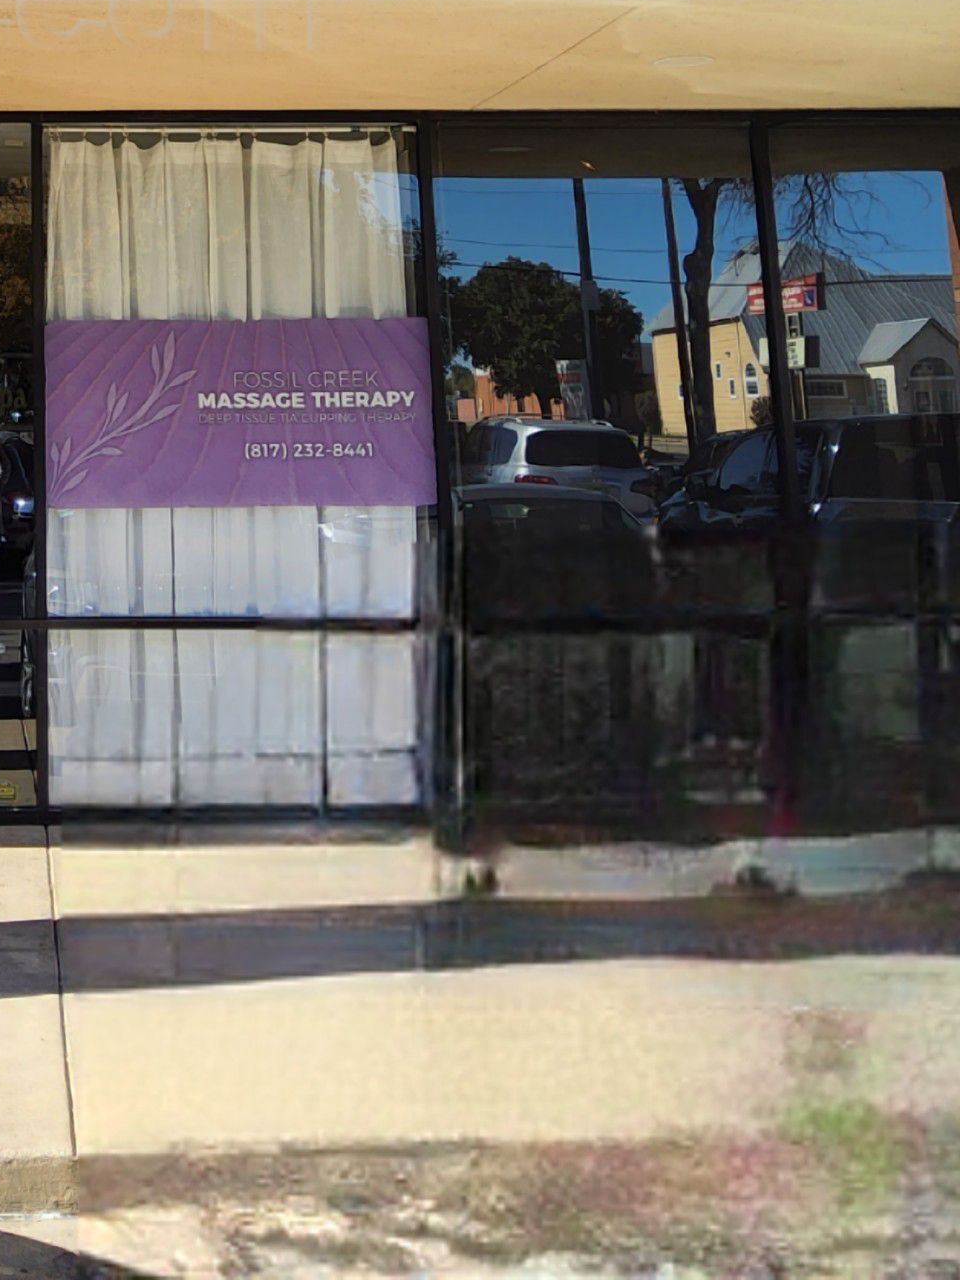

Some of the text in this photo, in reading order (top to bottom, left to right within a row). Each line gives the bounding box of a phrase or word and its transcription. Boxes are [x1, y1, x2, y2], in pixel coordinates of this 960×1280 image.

[232, 370, 379, 388] FOSSIL CREEK
[197, 391, 415, 409] MASSAGE THERAPY
[244, 442, 374, 459] (817) 232-8441
